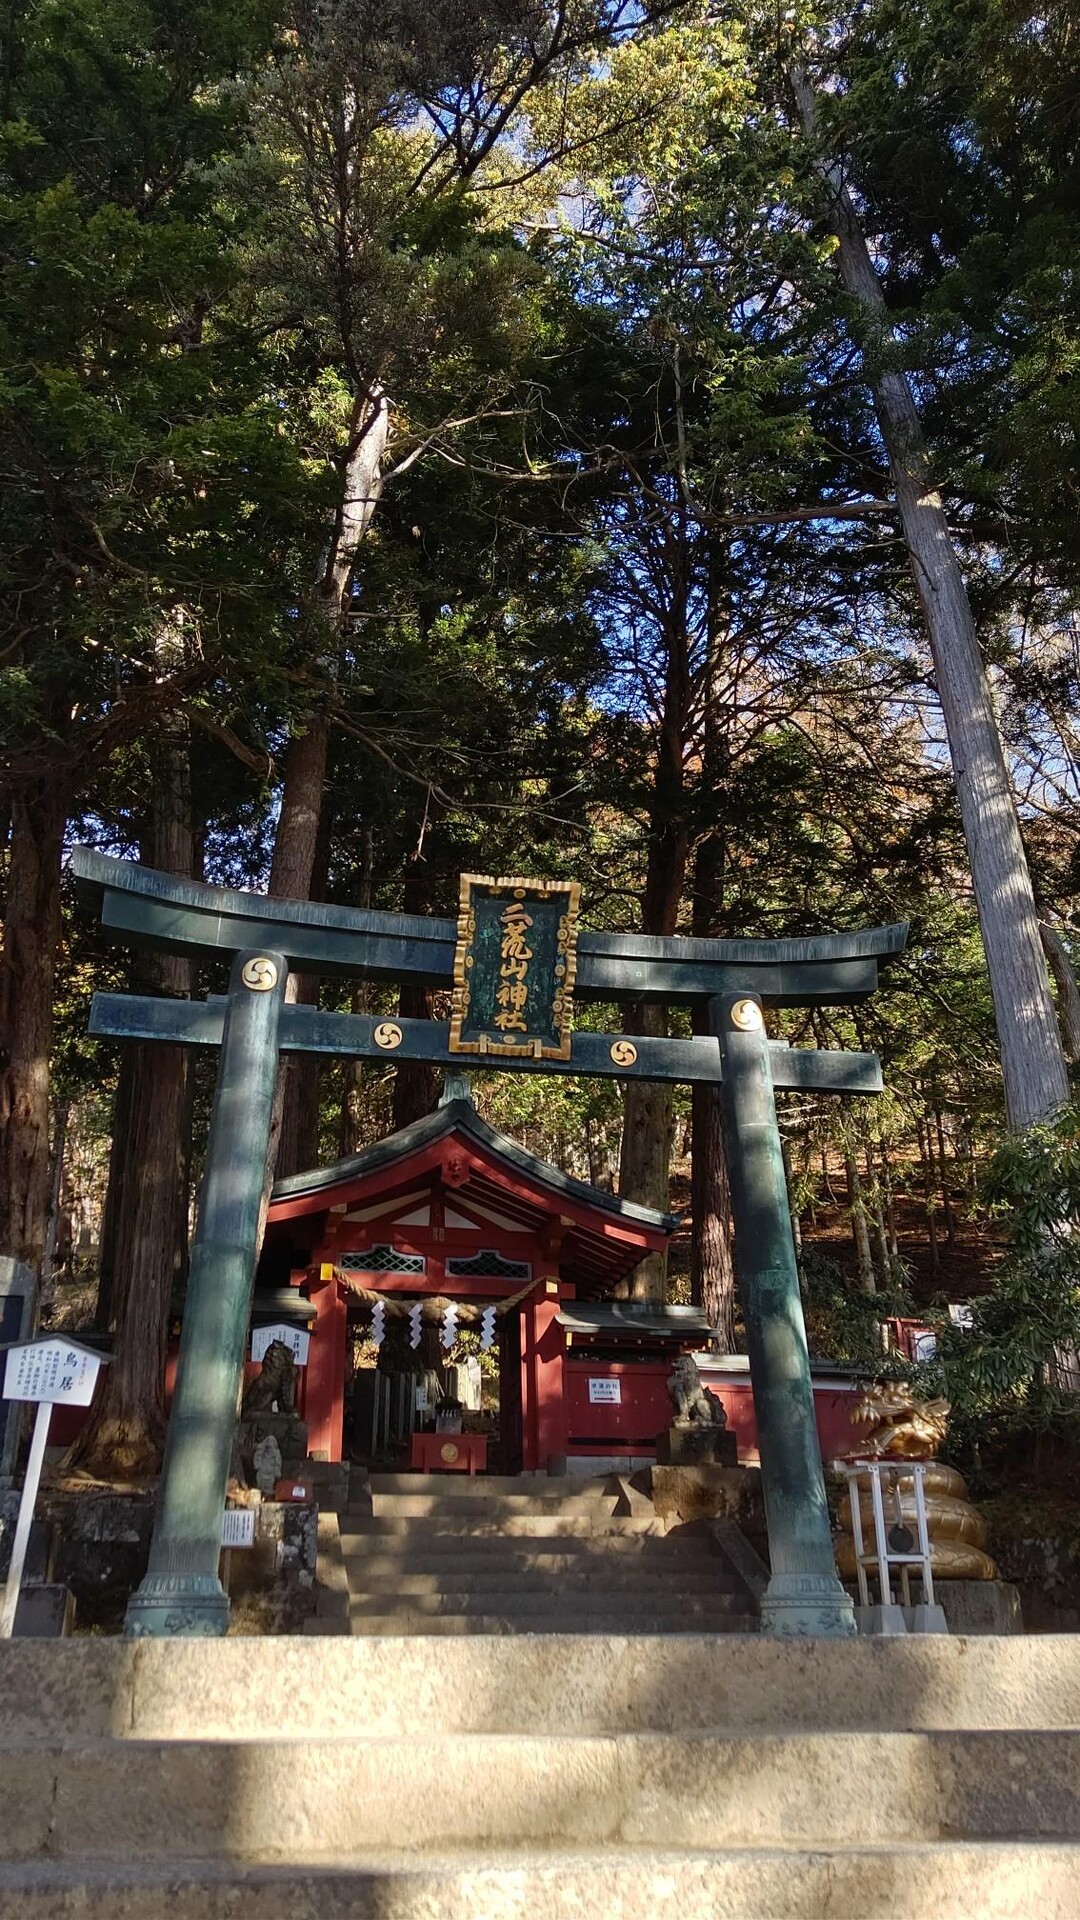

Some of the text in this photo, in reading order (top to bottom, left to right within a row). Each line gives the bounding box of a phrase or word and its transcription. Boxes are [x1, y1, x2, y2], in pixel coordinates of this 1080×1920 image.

[494, 902, 534, 1032] 二荒山神社
[60, 1351, 77, 1391] 鳥居
